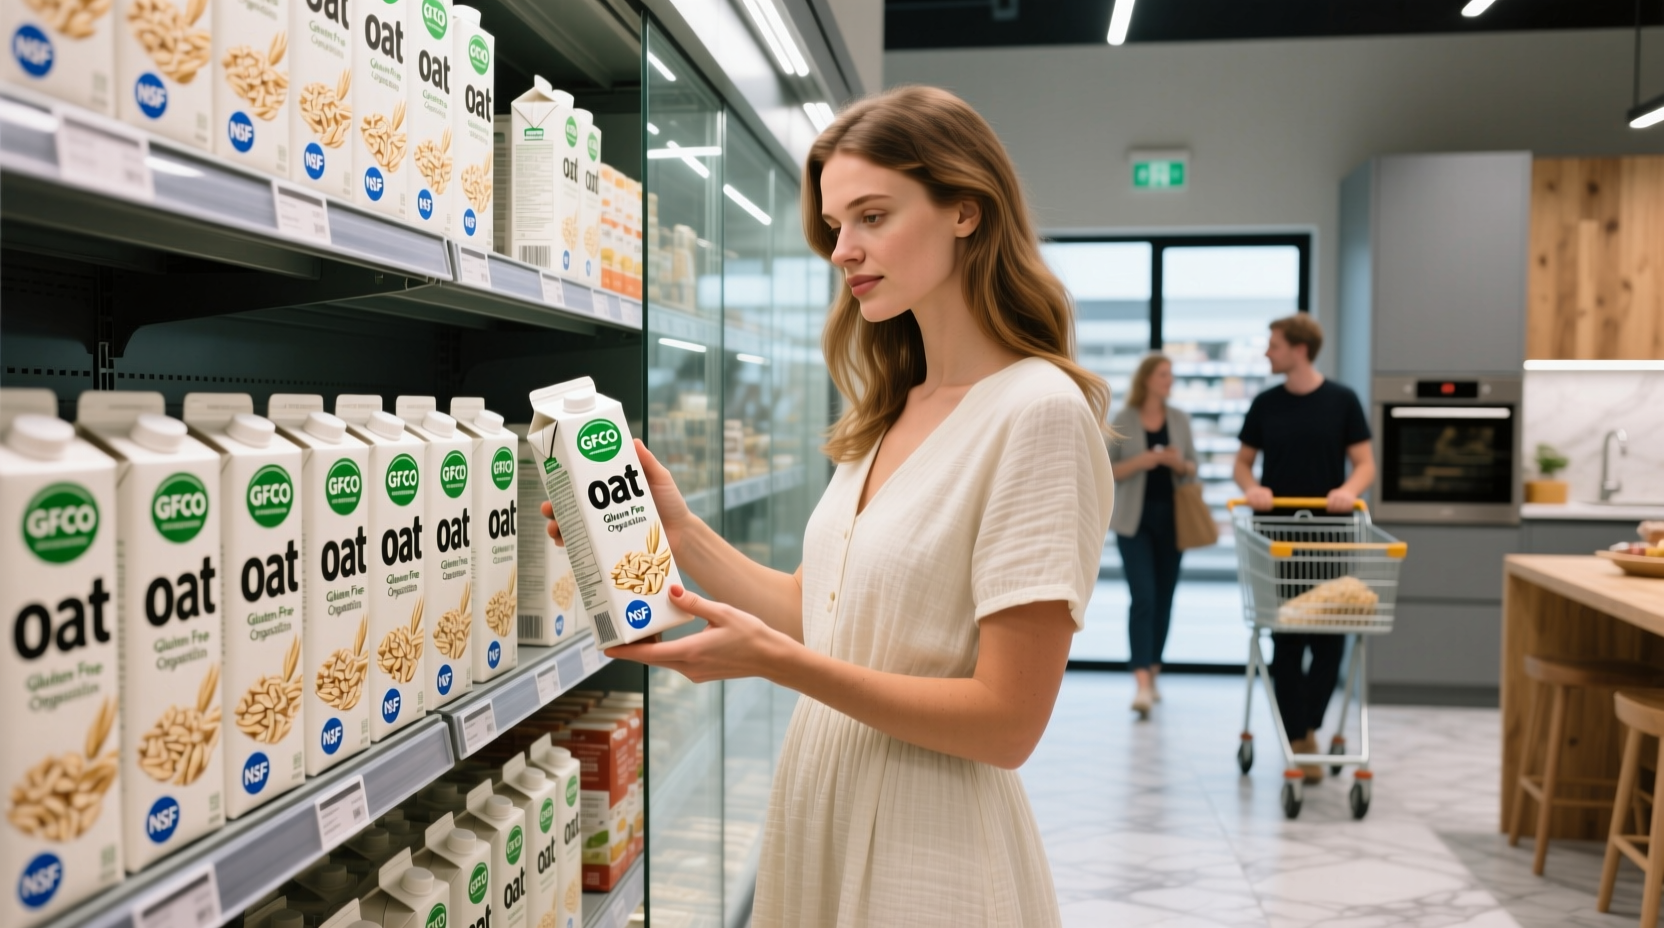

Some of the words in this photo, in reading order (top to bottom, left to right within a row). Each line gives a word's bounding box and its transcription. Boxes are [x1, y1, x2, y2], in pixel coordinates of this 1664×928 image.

[365, 14, 404, 64] oat
[419, 50, 451, 95] oat
[137, 84, 167, 109] NSF
[465, 84, 492, 123] oat
[229, 120, 253, 143] NSF
[580, 428, 618, 450] GFCO
[250, 482, 292, 507] GFCO
[328, 475, 361, 495] GFCO
[388, 469, 418, 488] GFCO
[588, 464, 645, 510] oat
[26, 507, 96, 538] GFCO
[154, 492, 207, 521] GFCO
[488, 500, 517, 539] oat
[381, 516, 423, 566] oat
[437, 508, 470, 553] oat
[241, 540, 299, 603] oat
[321, 526, 367, 582] oat
[145, 557, 216, 627] oat
[14, 578, 111, 661] oat
[628, 606, 649, 623] NSF
[322, 726, 342, 746] NSF
[244, 762, 268, 786] NSF
[148, 804, 180, 835] NSF
[21, 861, 61, 898] NSF
[504, 866, 526, 910] oat
